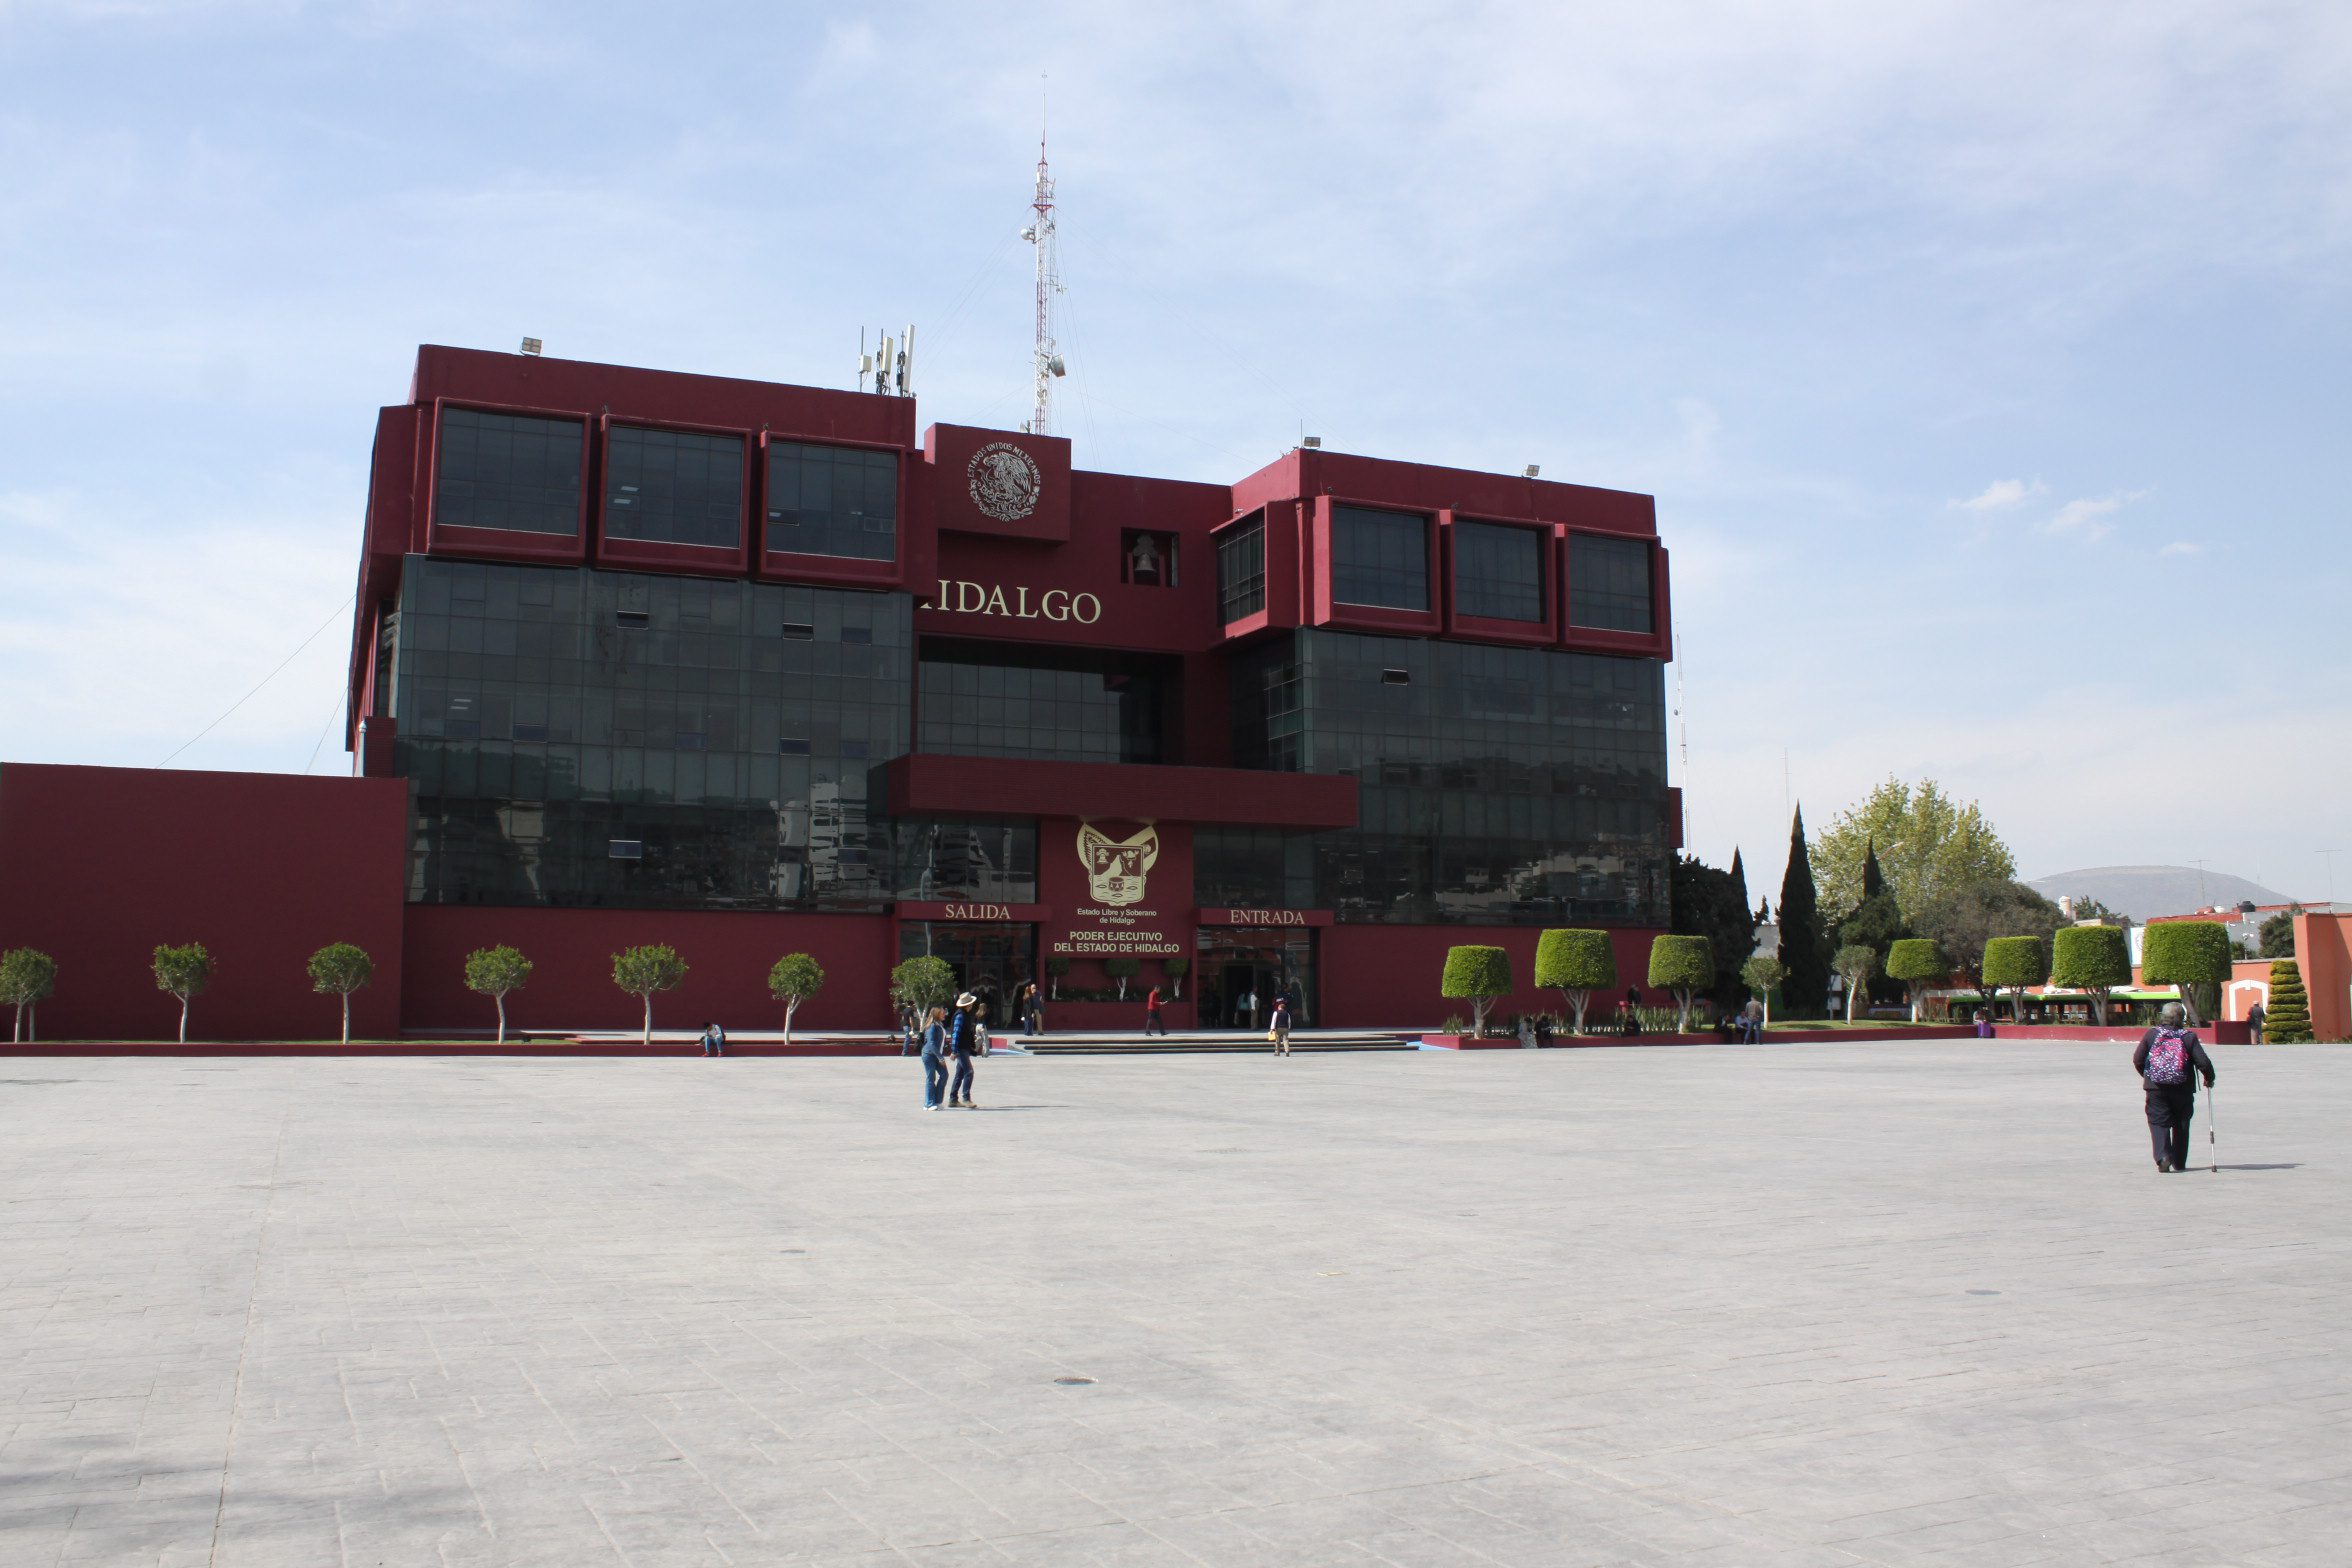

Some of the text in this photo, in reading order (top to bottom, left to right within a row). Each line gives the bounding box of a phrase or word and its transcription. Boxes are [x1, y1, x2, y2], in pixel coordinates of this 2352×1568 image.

[967, 442, 1041, 485] ESTADOS UNIDOS MEXICANOS
[920, 579, 1102, 624] IDALGO
[945, 903, 1011, 920] SALIDA
[1230, 909, 1305, 924] ENTRADA
[1110, 917, 1136, 925] Hidalgo
[1070, 932, 1162, 942] PODER EJECUTIVO
[1054, 942, 1180, 952] DEL ESTADO DE HIDALGO
